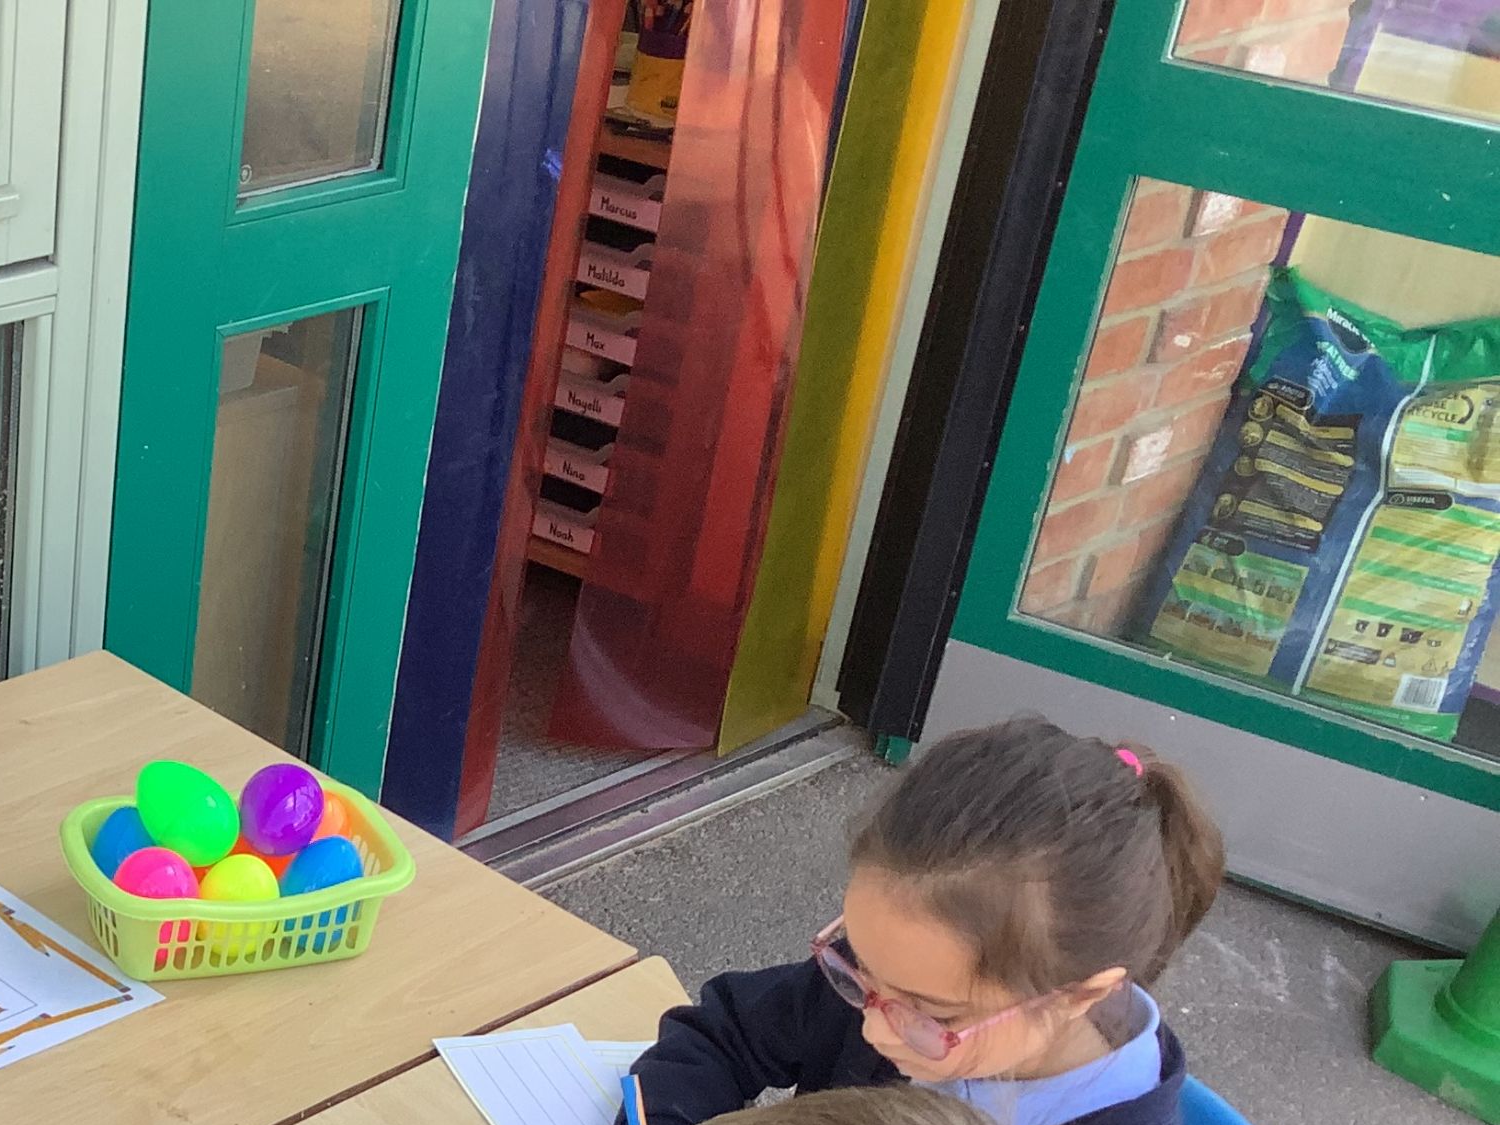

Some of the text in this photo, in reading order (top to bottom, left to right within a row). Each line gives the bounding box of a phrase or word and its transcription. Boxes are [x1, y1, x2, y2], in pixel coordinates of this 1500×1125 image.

[600, 196, 637, 220] Marcus
[588, 264, 625, 287] Matilda
[586, 332, 605, 351] Max
[549, 522, 574, 542] Noah
